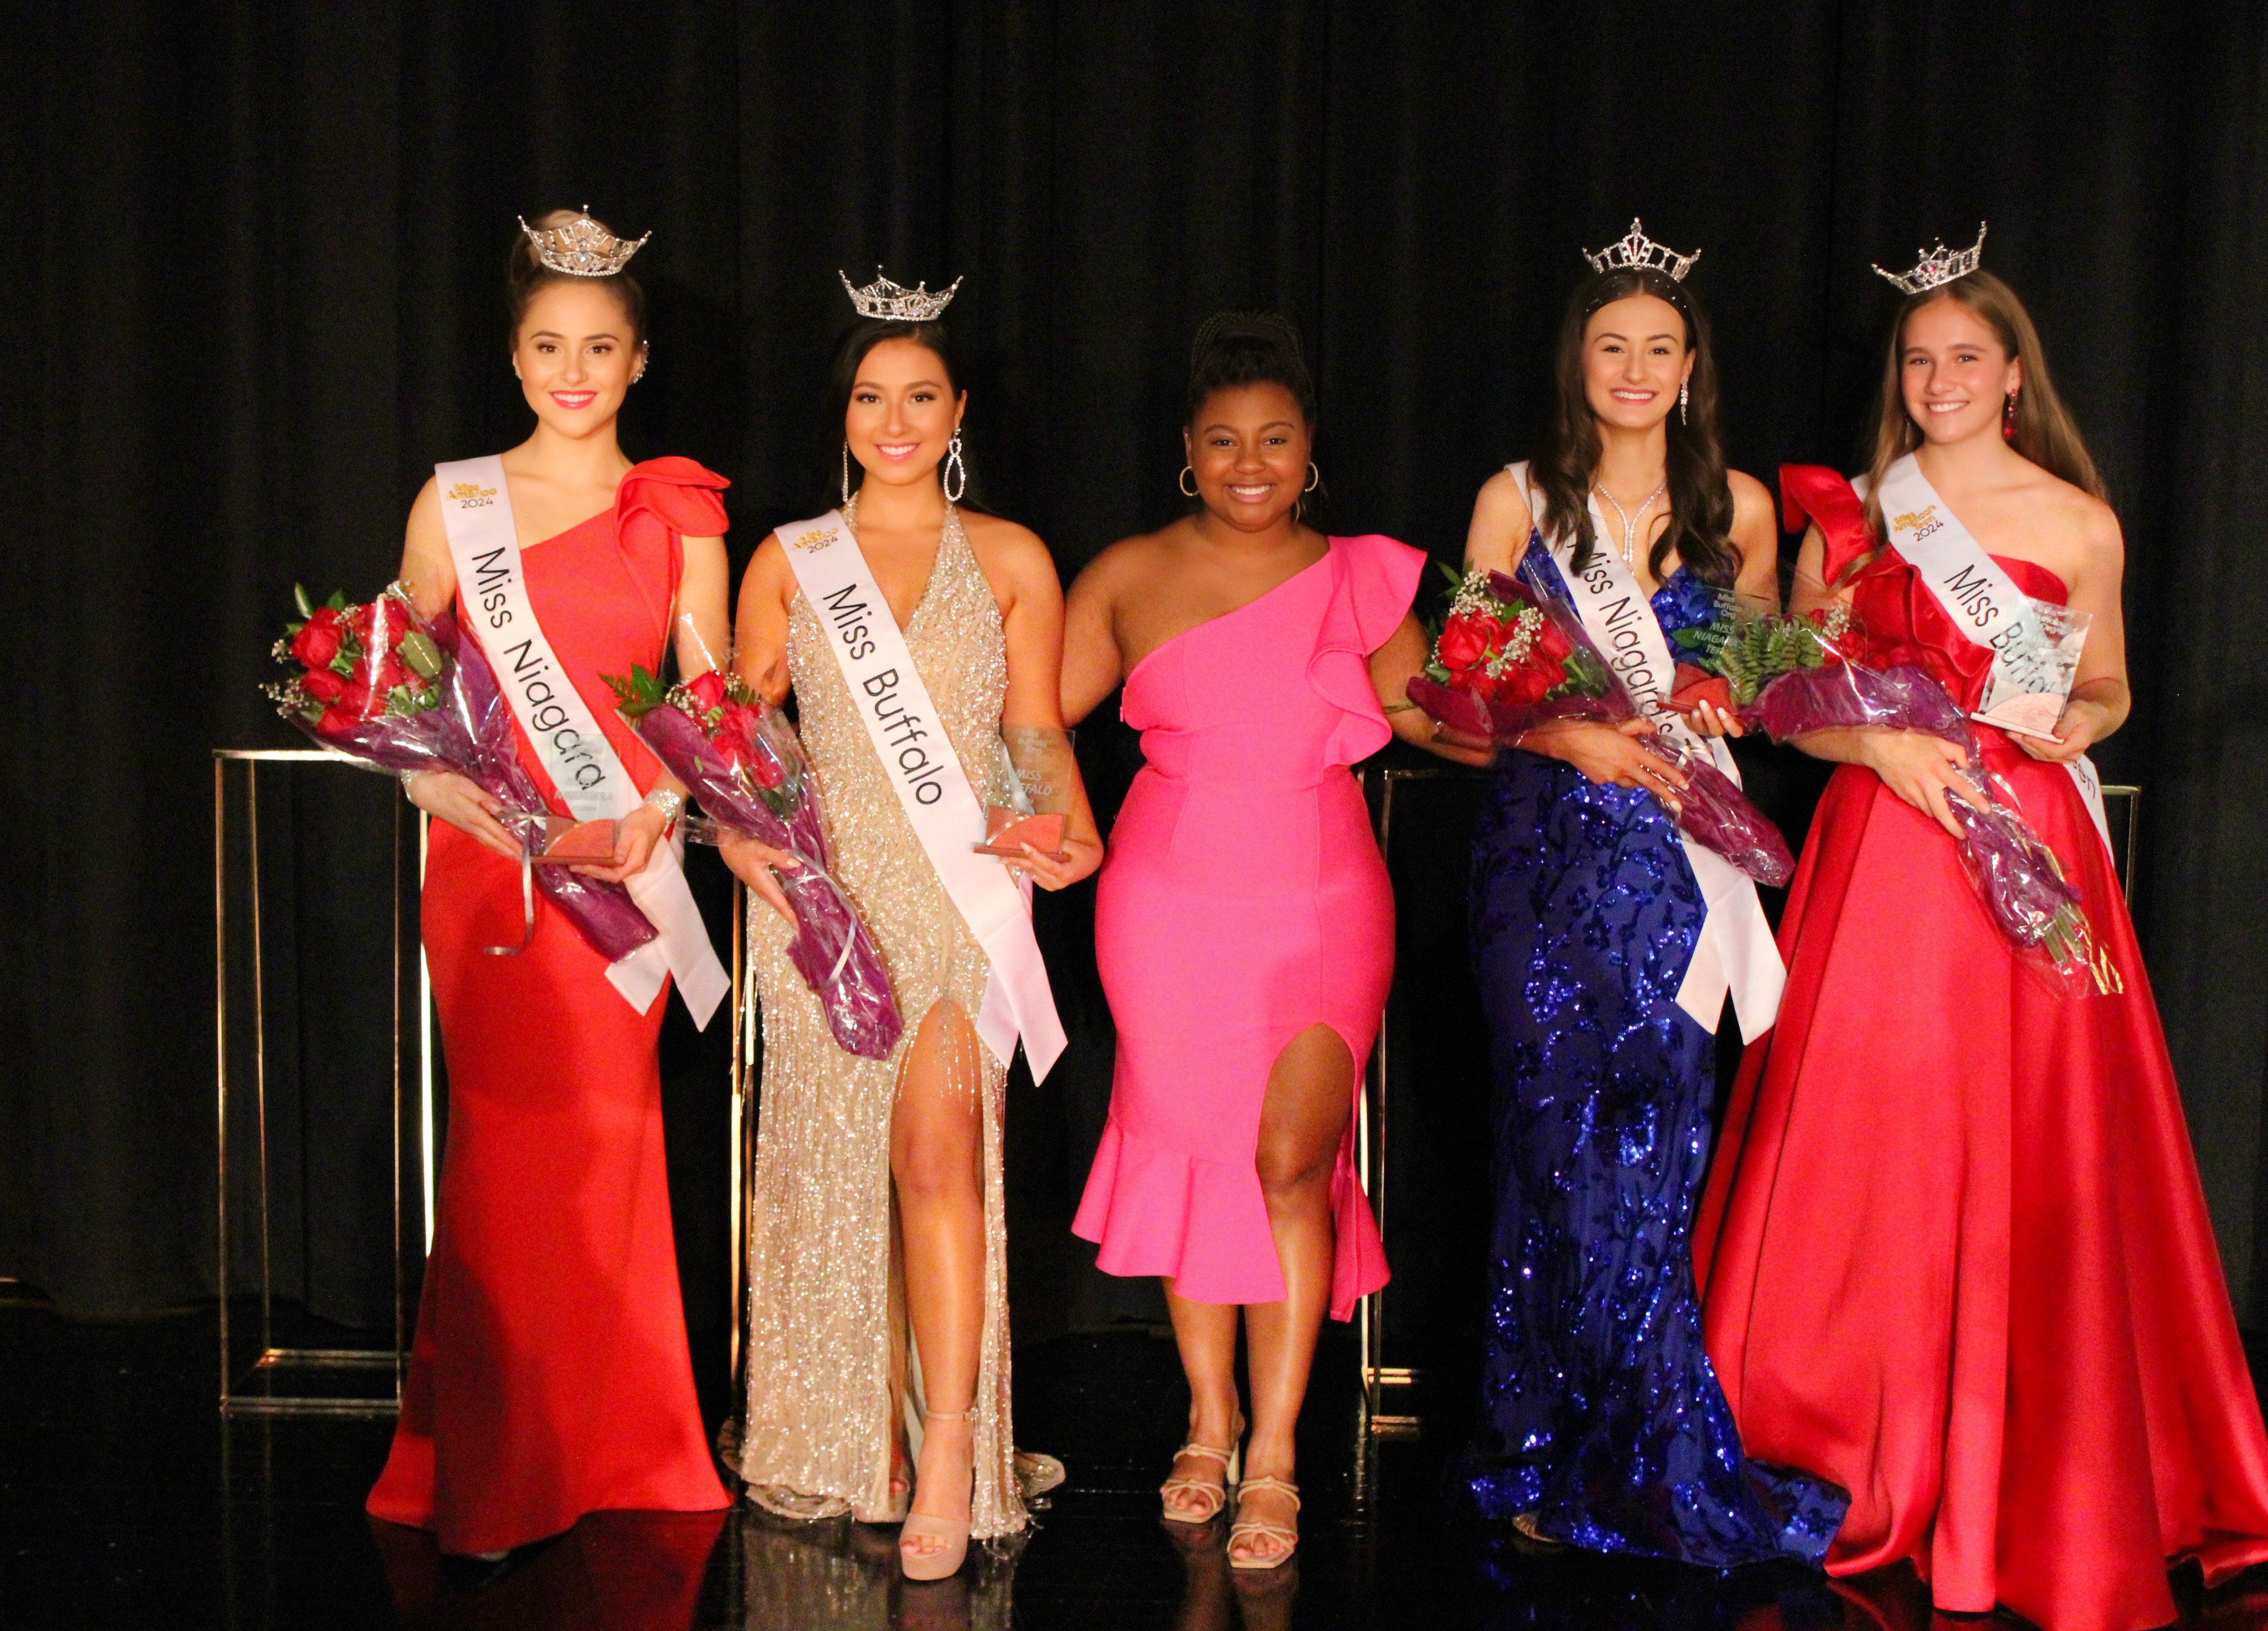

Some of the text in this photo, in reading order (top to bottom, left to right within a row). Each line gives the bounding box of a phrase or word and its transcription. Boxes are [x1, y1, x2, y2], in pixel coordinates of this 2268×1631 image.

[461, 497, 493, 509] 2024
[1914, 519, 1944, 542] 2024
[807, 536, 838, 554] 2024
[1713, 600, 1742, 612] Buffalo
[1721, 610, 1736, 620] Org
[1709, 622, 1735, 634] MISS
[1944, 564, 1998, 627] Miss
[1989, 621, 2055, 694] Buffa
[1693, 631, 1736, 647] NIAGA
[1706, 644, 1723, 655] TEE
[472, 546, 512, 628] Miss
[504, 639, 605, 790] Niagara
[823, 584, 944, 804] Miss Buffalo
[1016, 768, 1042, 781] MISS
[1002, 781, 1052, 796] BFFALO
